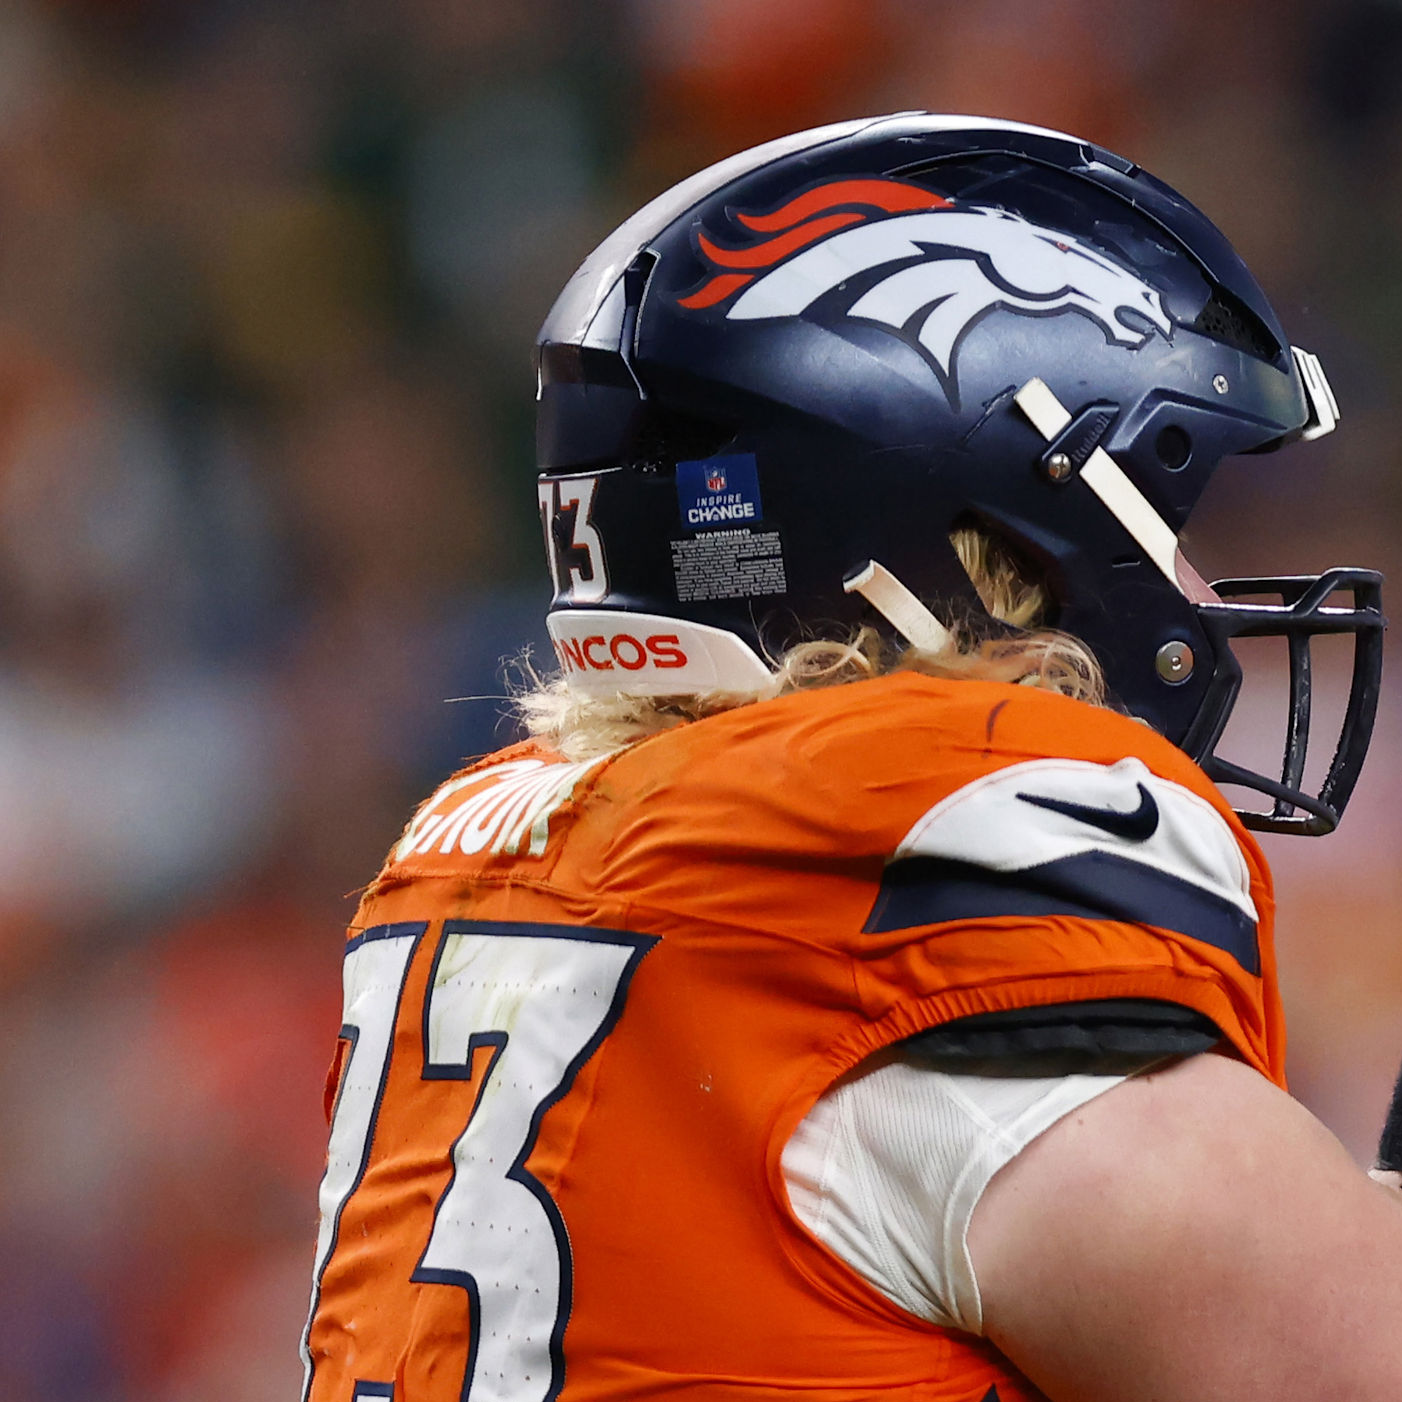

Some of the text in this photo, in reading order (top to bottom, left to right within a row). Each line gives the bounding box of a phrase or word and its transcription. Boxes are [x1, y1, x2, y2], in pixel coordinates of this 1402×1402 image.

[696, 493, 742, 507] INSPIRE
[687, 502, 755, 523] CHANGE
[695, 528, 751, 539] WARNING
[553, 634, 688, 672] NCOS
